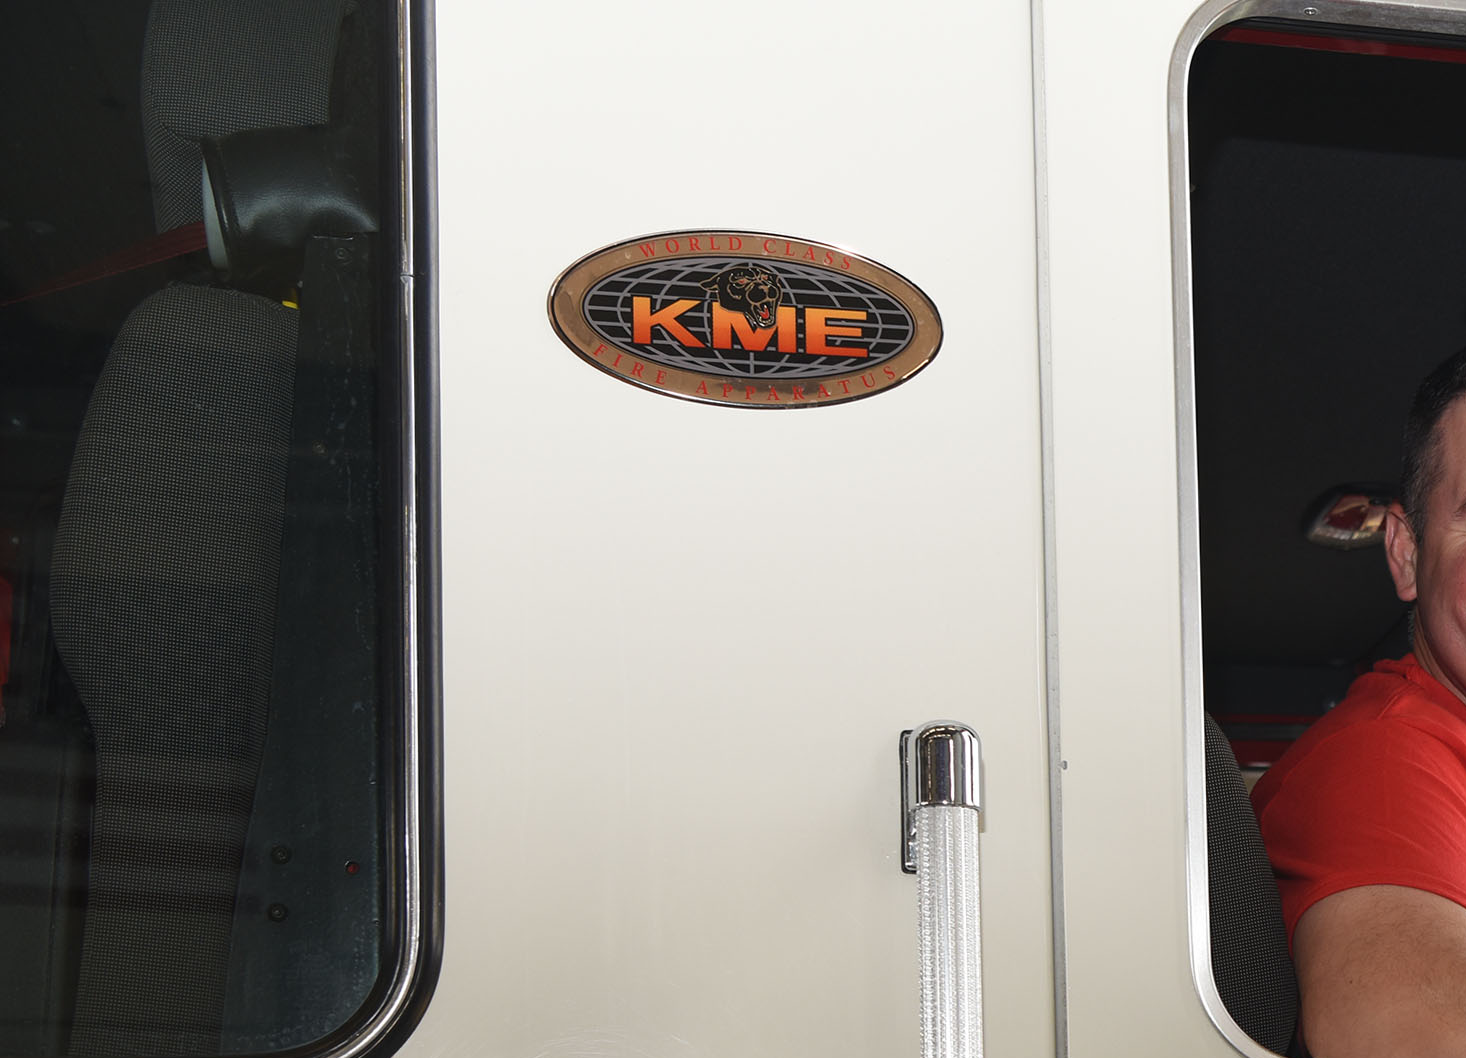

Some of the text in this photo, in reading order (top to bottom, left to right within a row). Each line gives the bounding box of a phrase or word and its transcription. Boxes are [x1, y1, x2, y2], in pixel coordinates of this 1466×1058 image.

[638, 236, 853, 271] WORLD CLASS
[631, 295, 869, 358] KME
[592, 342, 897, 401] FIRE APPARATUS
